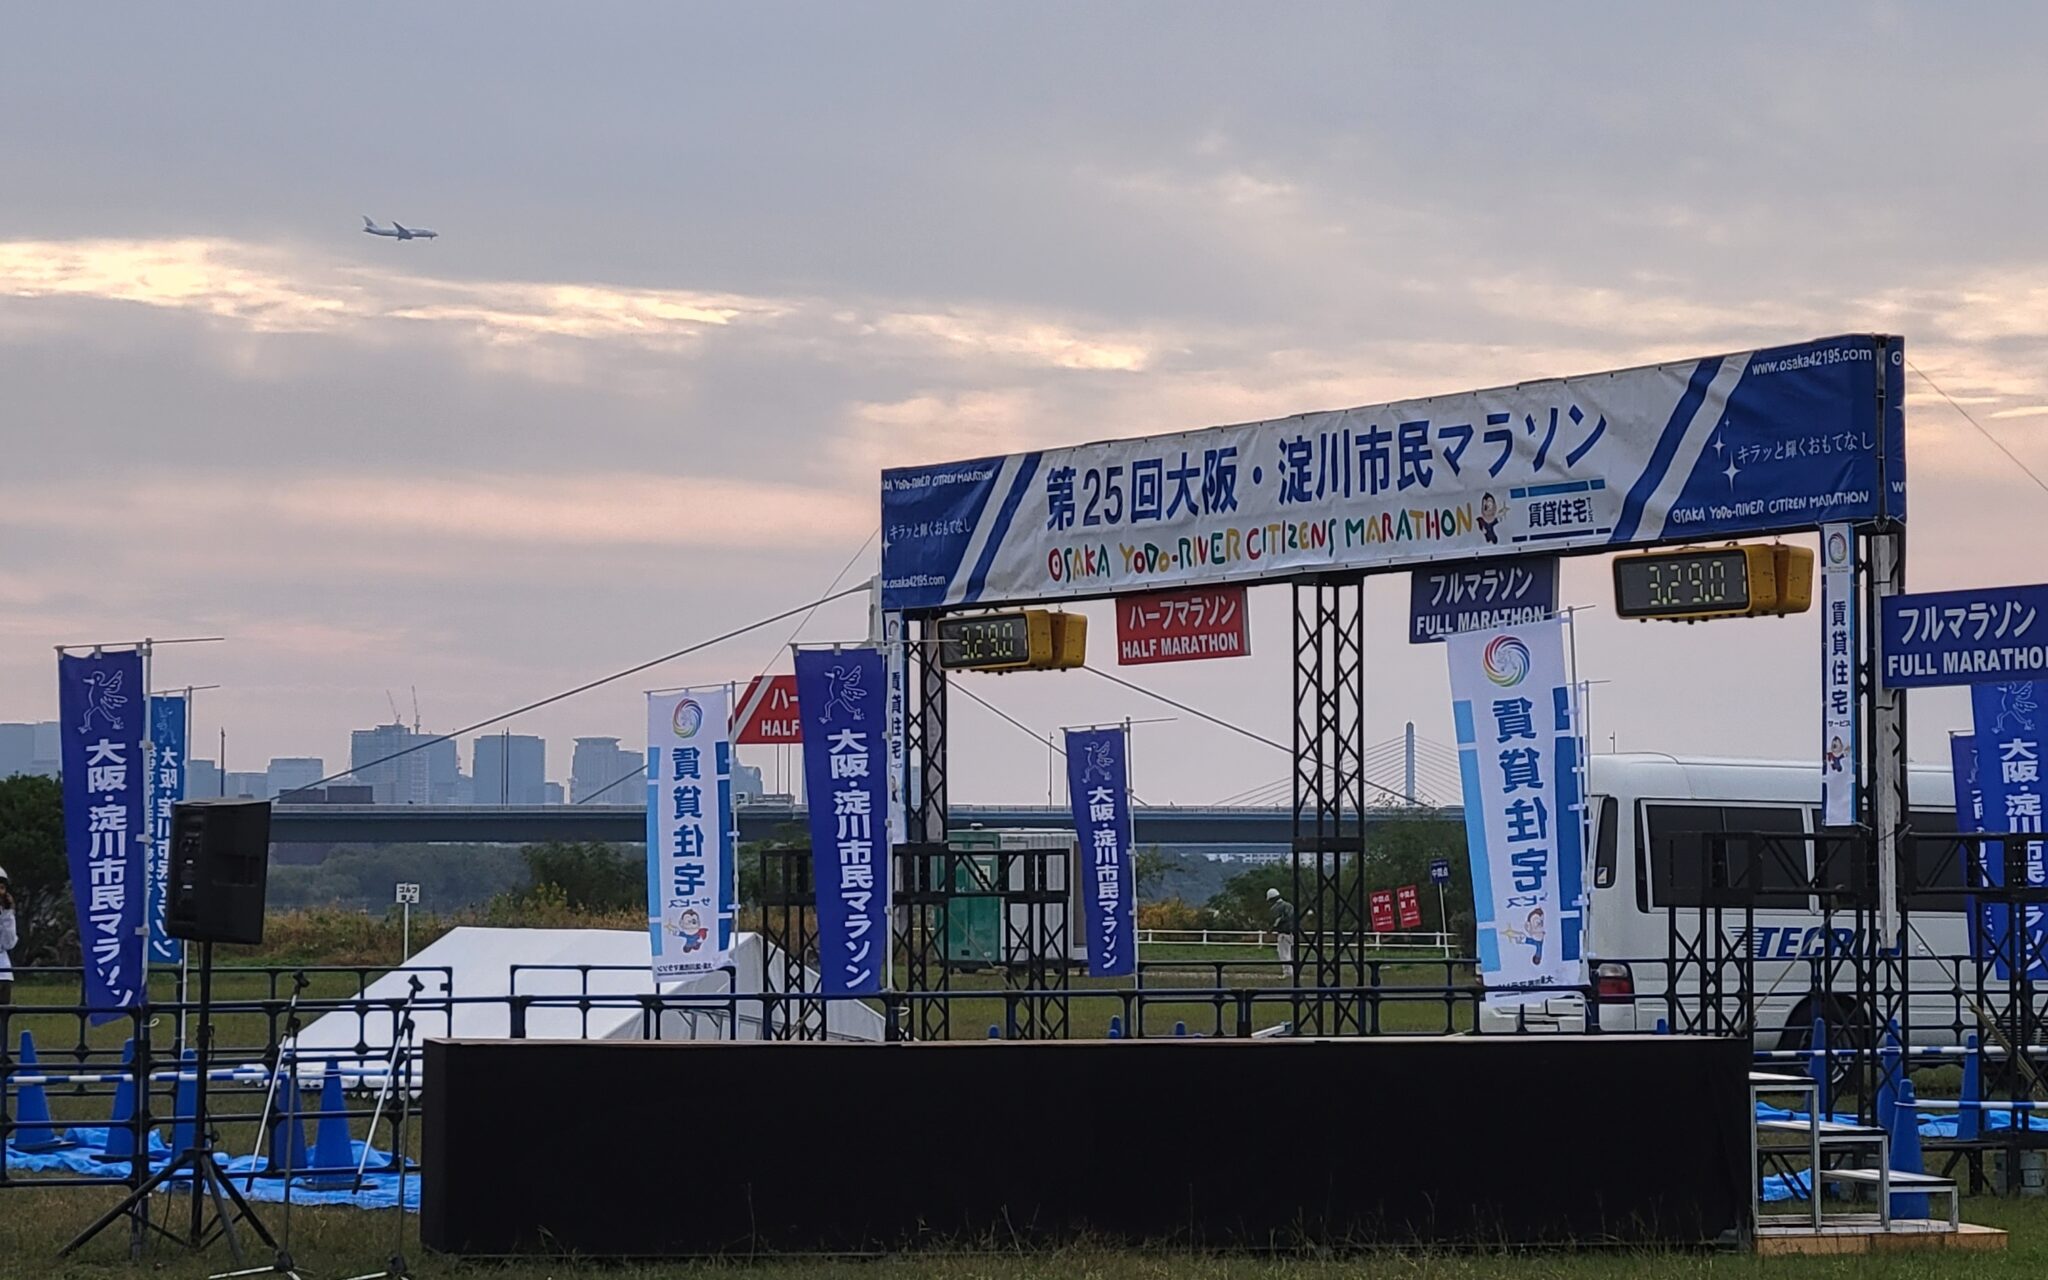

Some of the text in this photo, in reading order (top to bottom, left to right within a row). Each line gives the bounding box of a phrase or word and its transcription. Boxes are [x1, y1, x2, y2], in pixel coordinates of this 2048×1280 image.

[1752, 348, 1872, 375] www.osaka42195.com
[1737, 431, 1875, 464] キラッと輝くおもてなし
[1529, 498, 1587, 528] 賃貸住宅
[1672, 508, 1705, 523] OSAKA
[1769, 497, 1807, 514] CITIZEN
[1809, 491, 1869, 509] MARATHON
[1048, 547, 1111, 583] OSAKA
[1246, 517, 1337, 561] CITIZENS
[1345, 502, 1473, 547] MARATHON
[1430, 567, 1533, 606] フルマラソン
[1129, 595, 1236, 630] ハーフマラソン
[1416, 605, 1546, 636] FULL MARATHON
[1898, 601, 2036, 645] フルマラソン
[1122, 632, 1239, 660] HALF MARATHON
[1831, 601, 1848, 715] 賃貸住宅
[1888, 646, 2048, 677] FULL MARATHO
[761, 719, 800, 737] HALF
